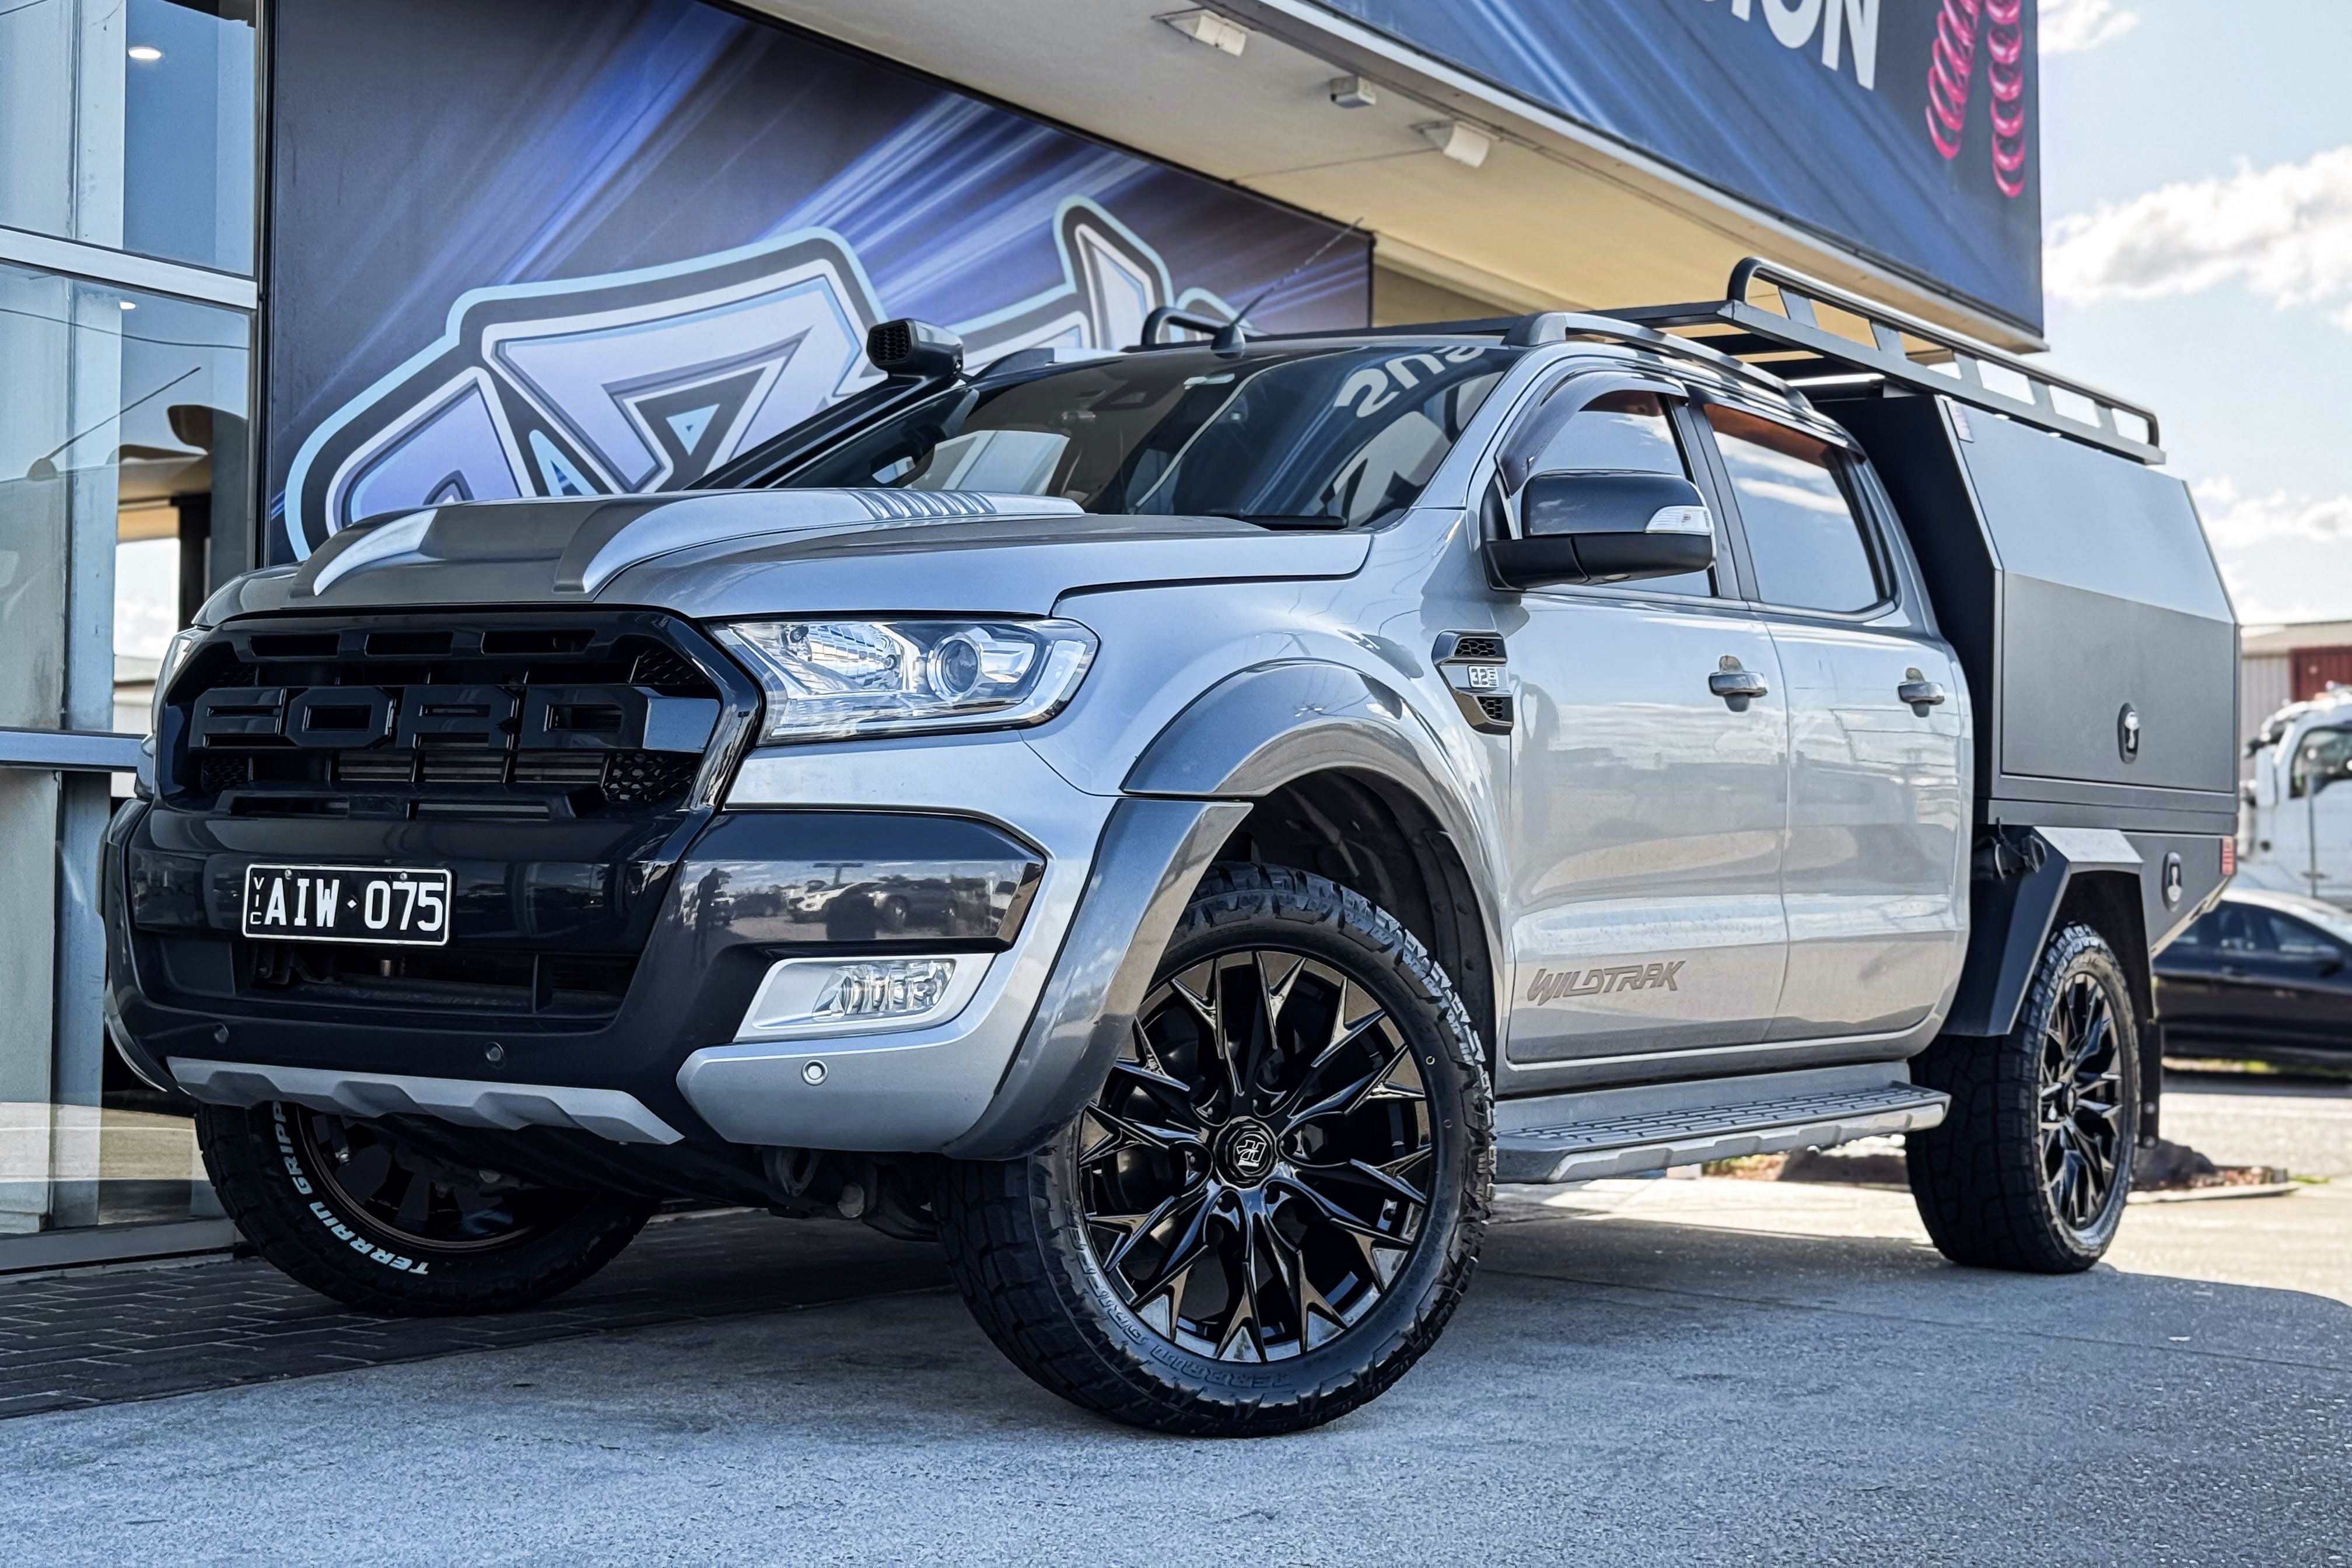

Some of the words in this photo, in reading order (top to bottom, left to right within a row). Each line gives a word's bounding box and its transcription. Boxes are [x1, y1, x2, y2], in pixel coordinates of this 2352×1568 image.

[189, 683, 648, 751] FORD
[250, 877, 265, 925] VIC
[1527, 961, 1686, 1006] WILDTRAK
[309, 1201, 429, 1275] TERRAIN
